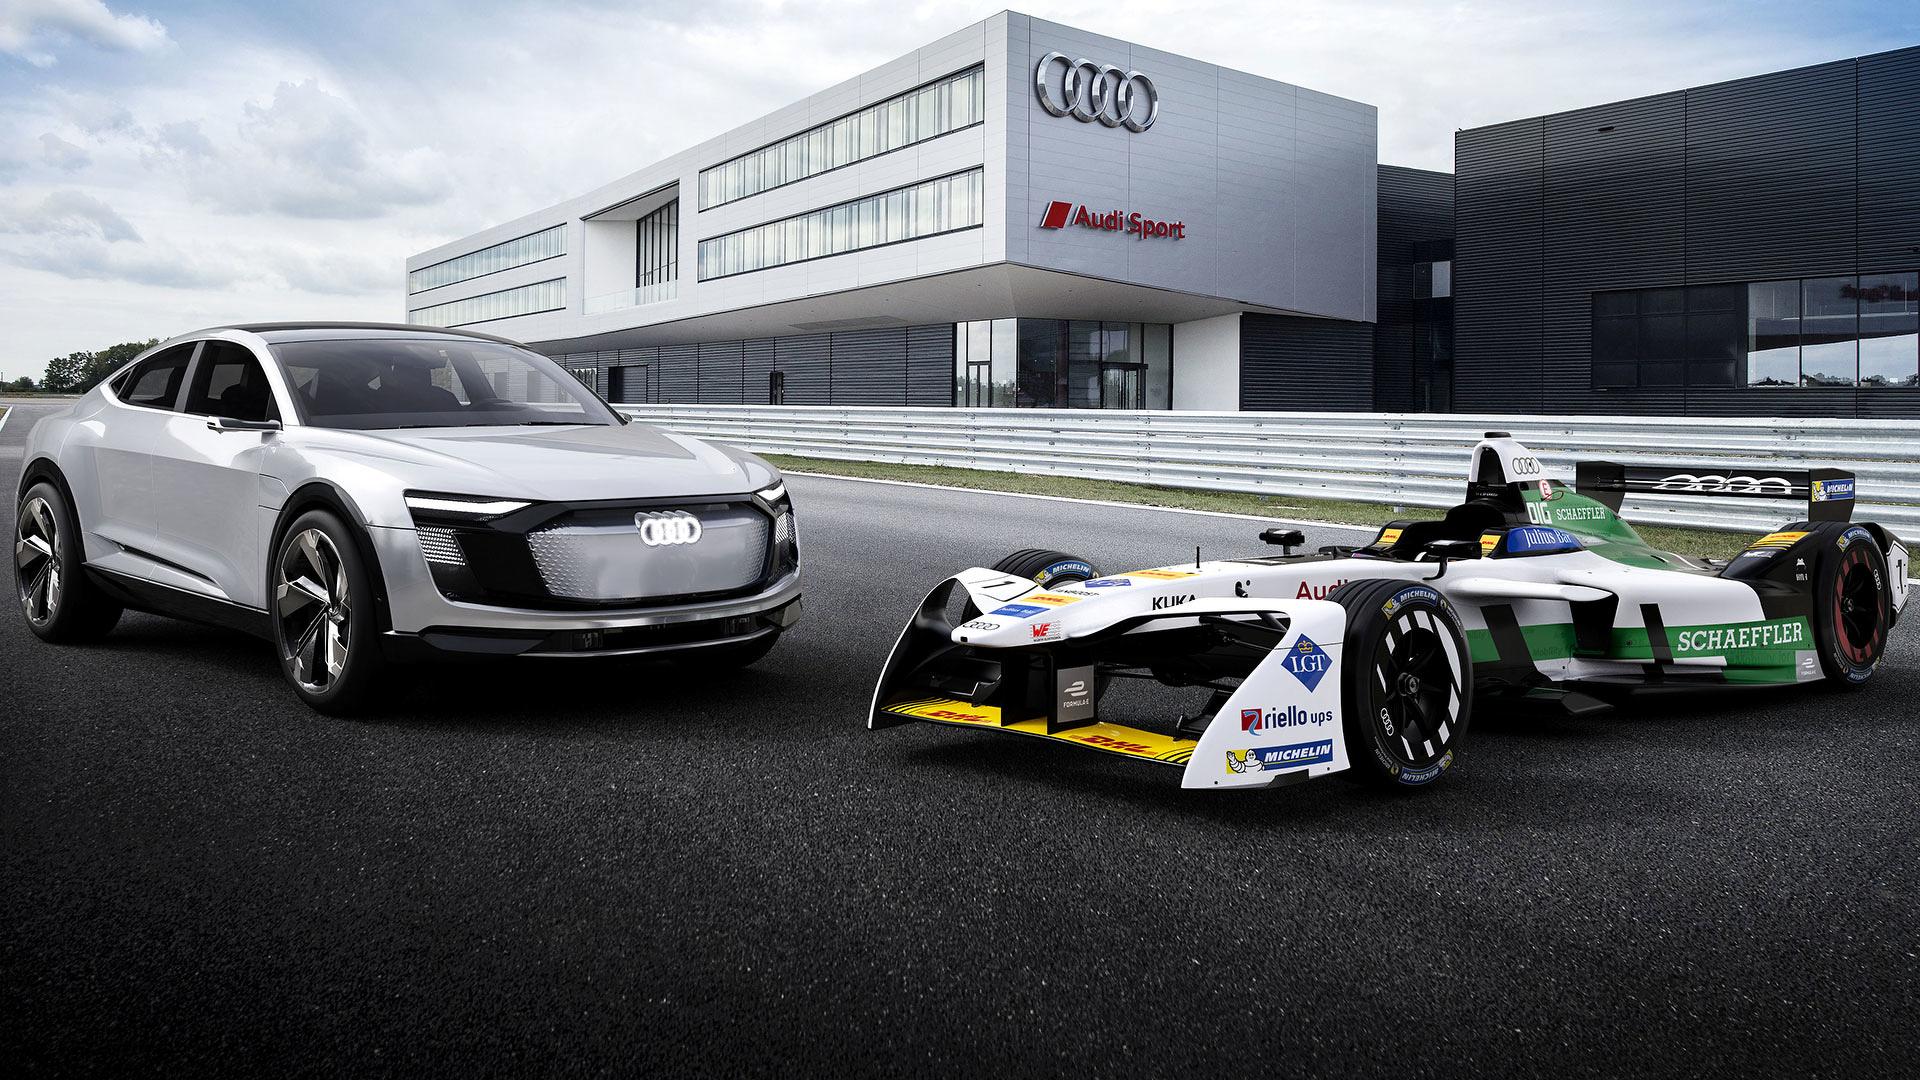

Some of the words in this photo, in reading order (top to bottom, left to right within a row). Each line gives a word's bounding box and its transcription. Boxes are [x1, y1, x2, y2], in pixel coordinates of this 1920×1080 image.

[1072, 204, 1124, 231] Audi
[1128, 211, 1186, 239] Sport
[1526, 502, 1552, 525] DIG
[1556, 507, 1606, 521] SCHAEFFLER
[1523, 528, 1556, 548] Julius
[1052, 563, 1090, 574] MICHELIN
[1896, 559, 1904, 594] 1
[1296, 579, 1348, 600] Aud
[1400, 590, 1437, 603] MICHELIN
[1677, 622, 1803, 652] SCHAEFFLER
[1291, 653, 1326, 673] LGT
[1264, 705, 1308, 730] riello
[1310, 709, 1333, 723] ups
[1264, 744, 1331, 763] MICHELIN
[1402, 767, 1439, 781] MICHELIN
